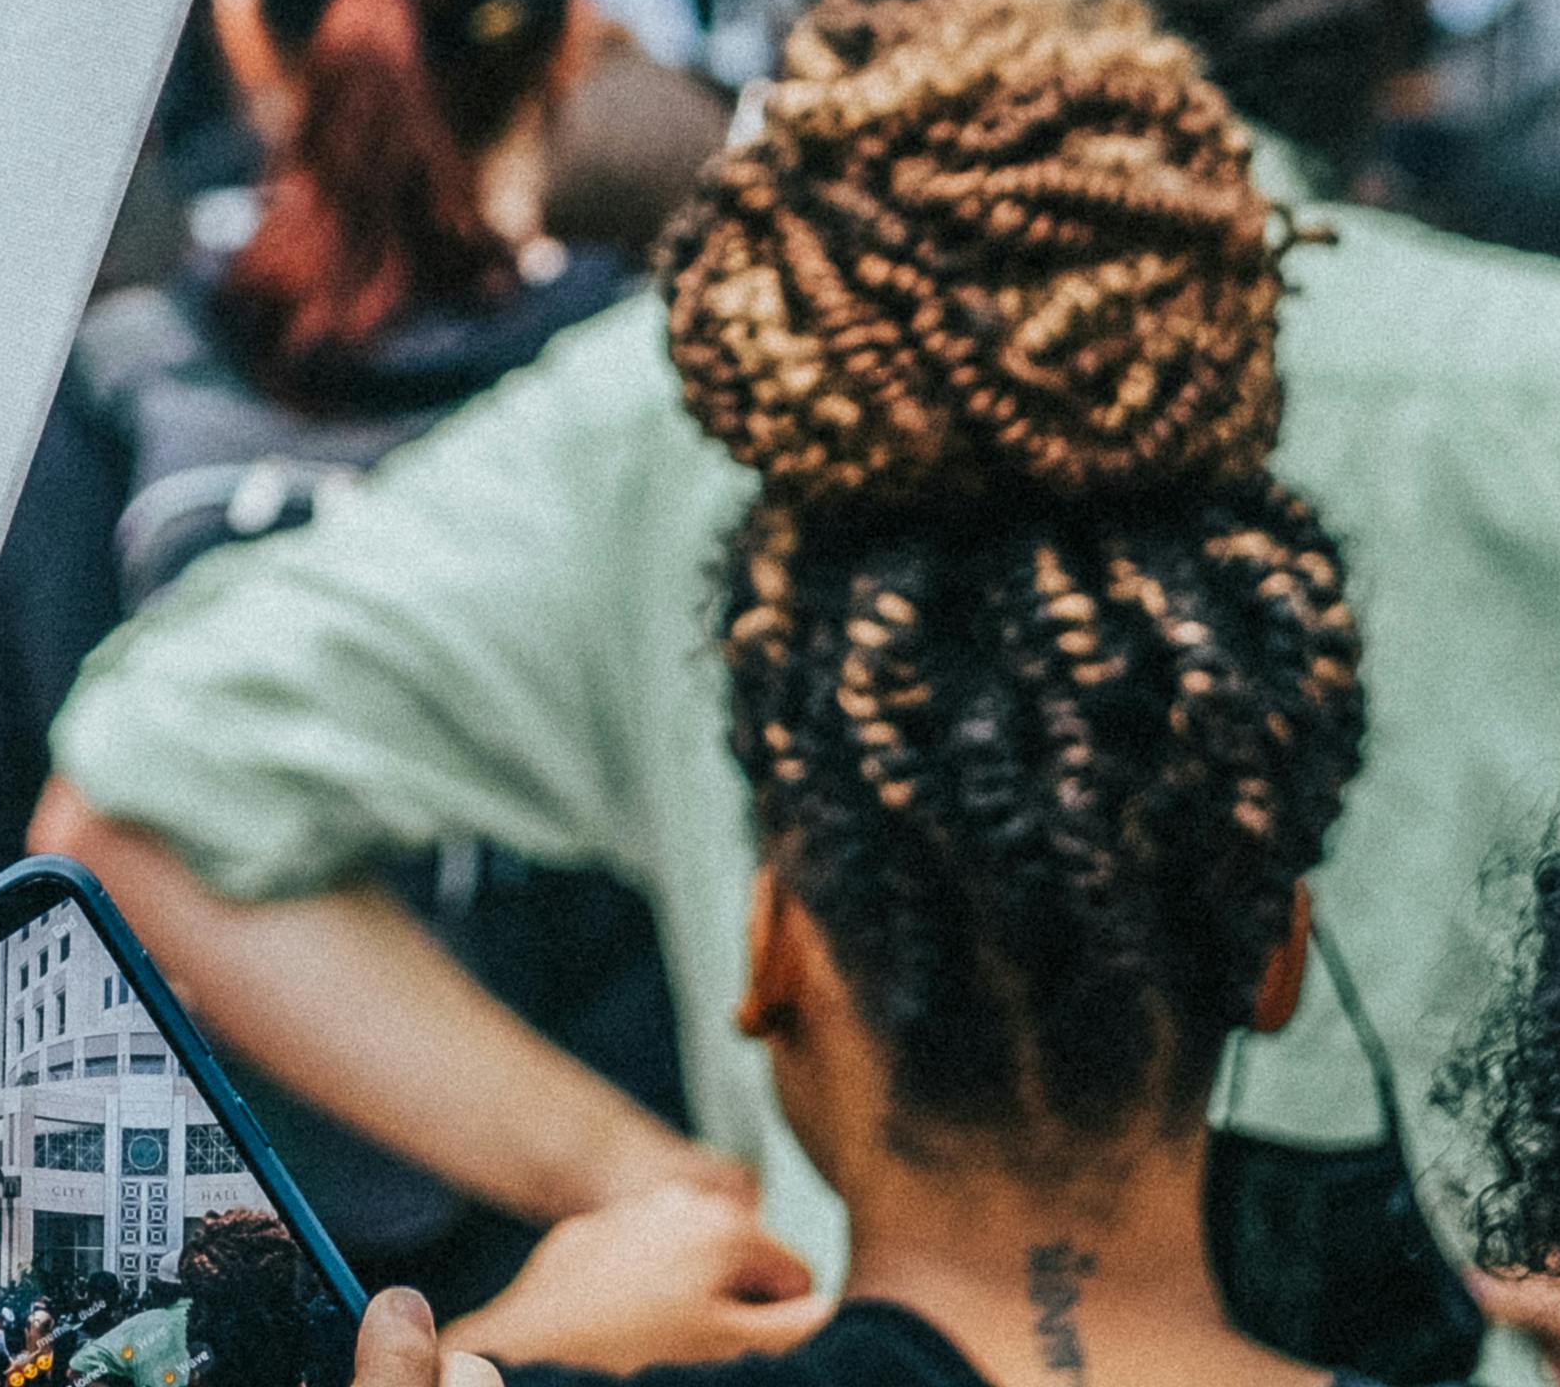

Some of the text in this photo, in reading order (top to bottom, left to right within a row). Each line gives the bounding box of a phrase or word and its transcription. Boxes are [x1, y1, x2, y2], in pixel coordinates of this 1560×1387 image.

[51, 1186, 239, 1202] CITY HALL
[175, 1350, 210, 1375] Wave
